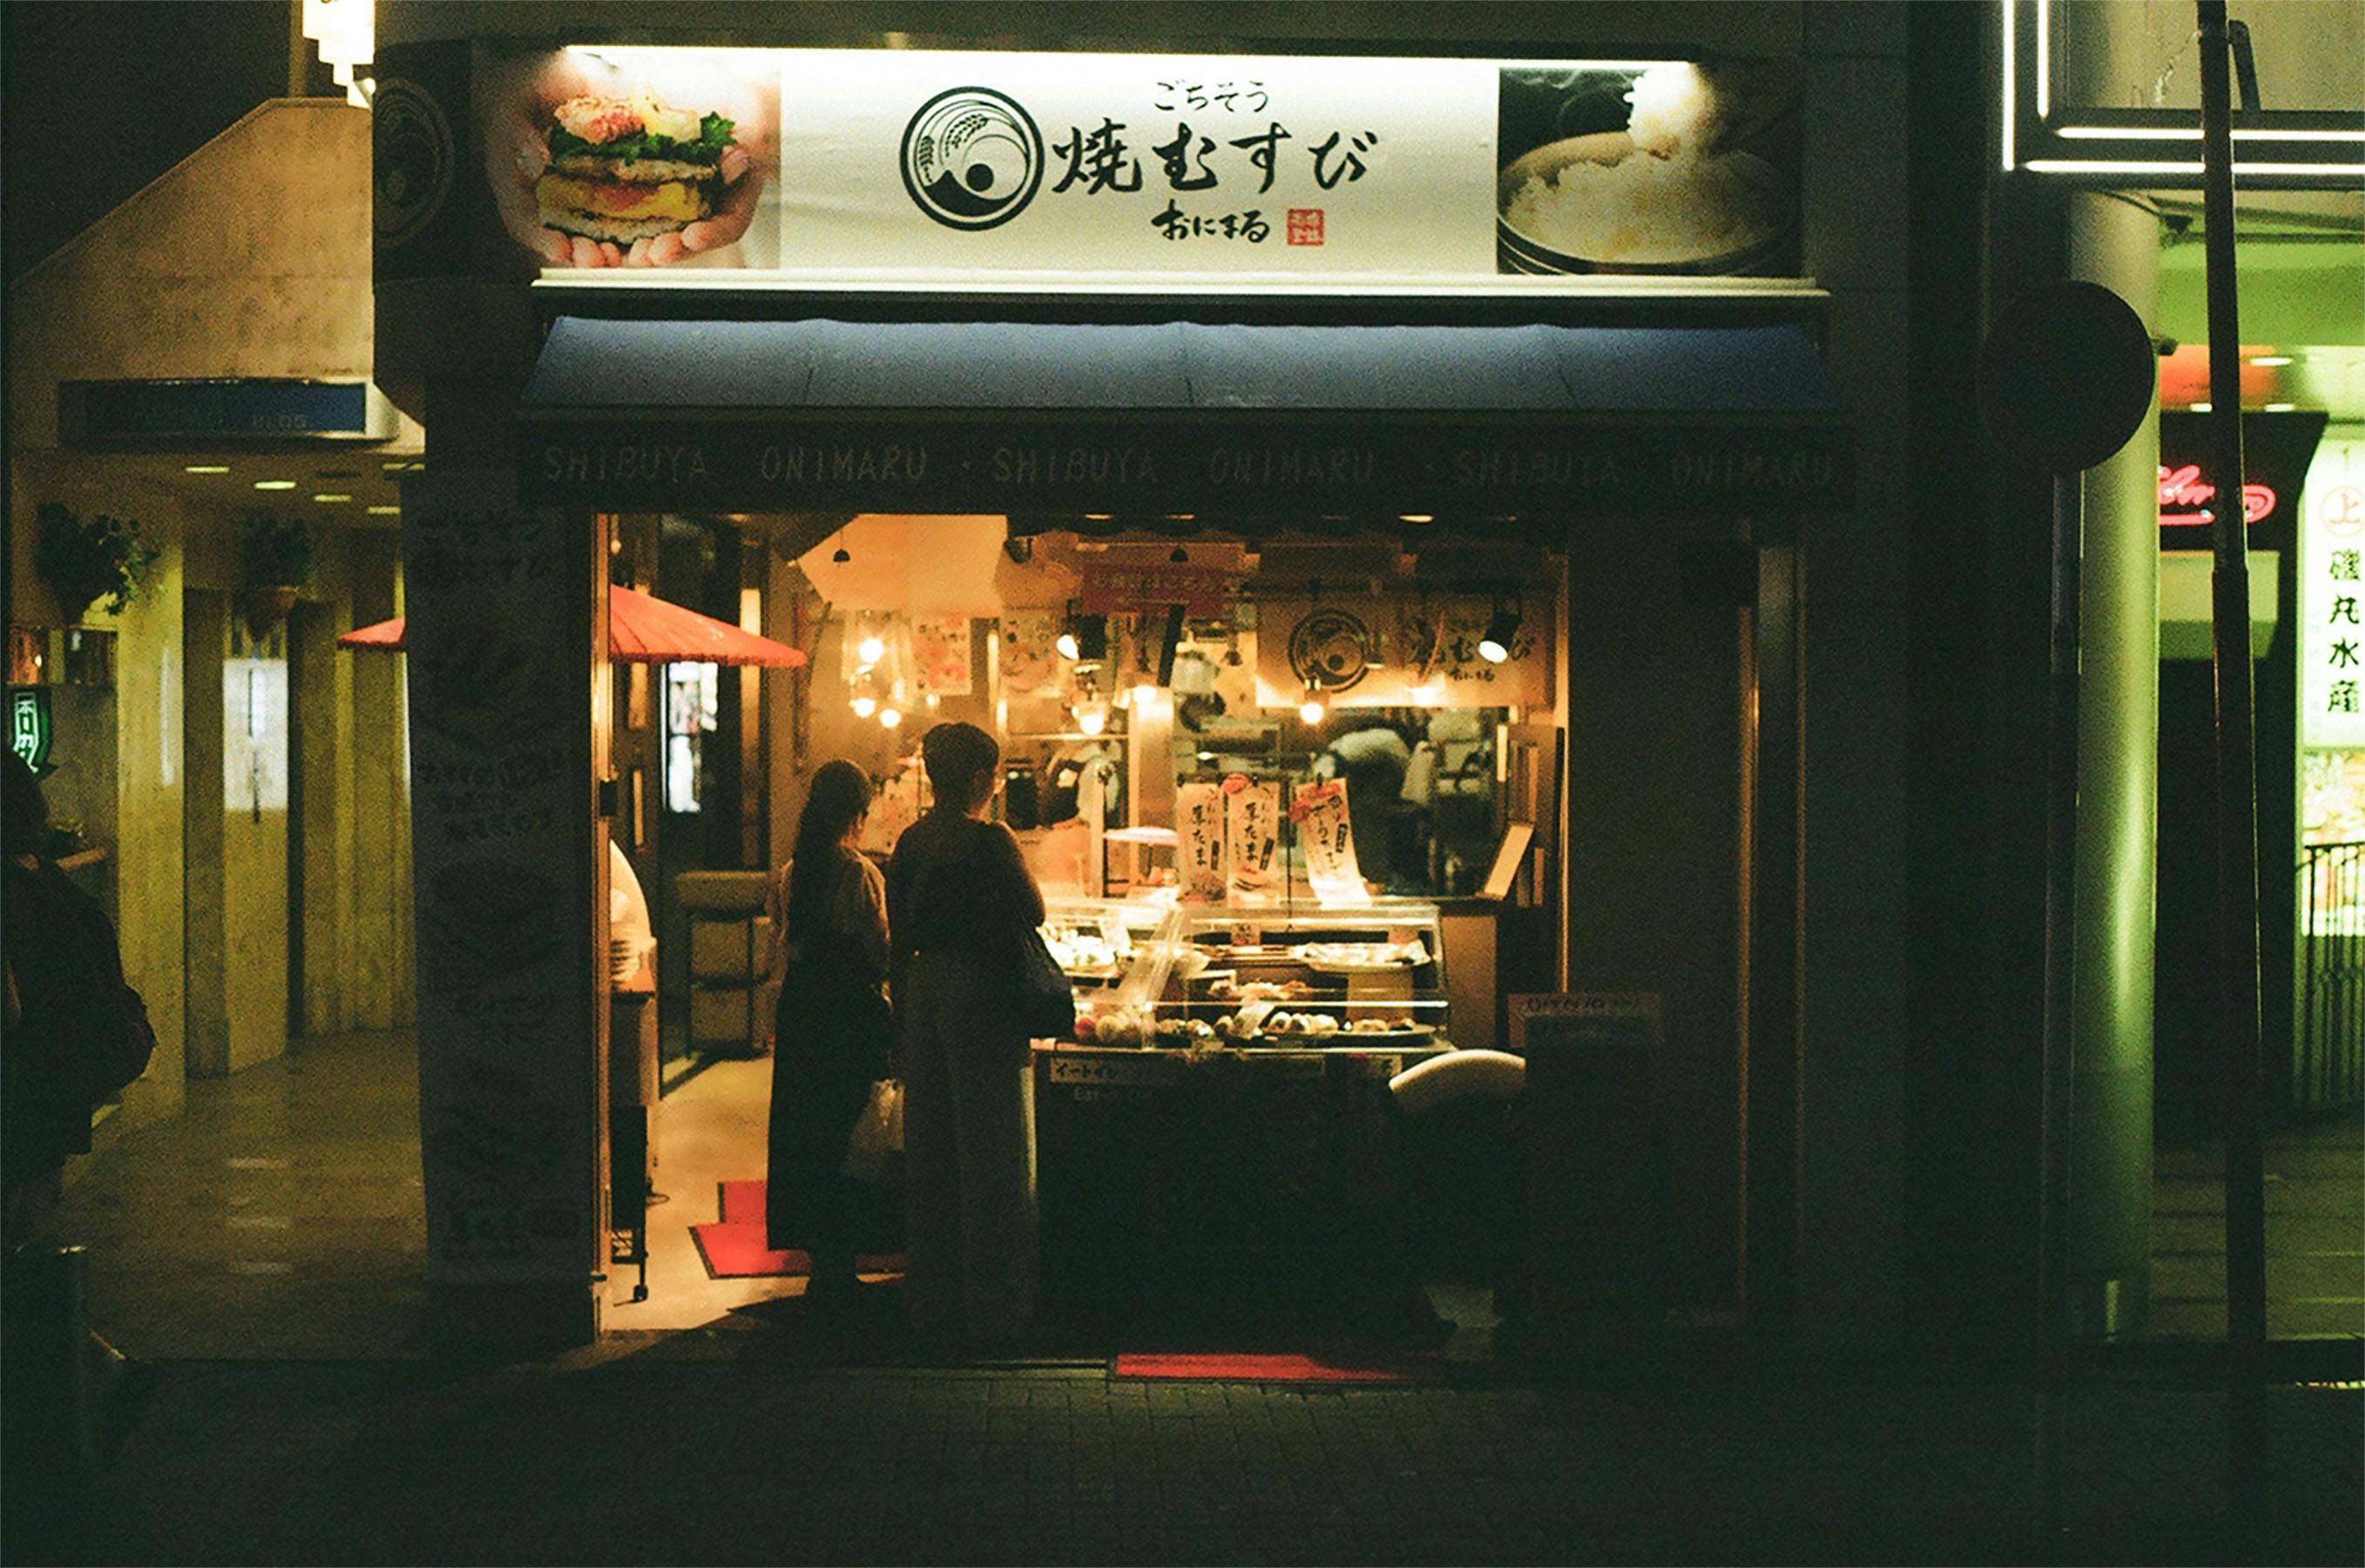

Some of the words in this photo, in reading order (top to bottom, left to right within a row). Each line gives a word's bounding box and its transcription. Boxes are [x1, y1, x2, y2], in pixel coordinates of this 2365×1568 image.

[1153, 78, 1270, 113] ごちそう
[1051, 117, 1379, 195] 焼むすび
[1151, 199, 1271, 243] おにまる
[542, 445, 711, 483] SHIBUYA
[759, 445, 929, 483] ONIMARU
[992, 446, 1159, 484] SHIBUYA
[1208, 447, 1375, 484] ONIMARU
[1456, 448, 1622, 485] SHIBUYA
[1669, 448, 1835, 486] ONIMARU
